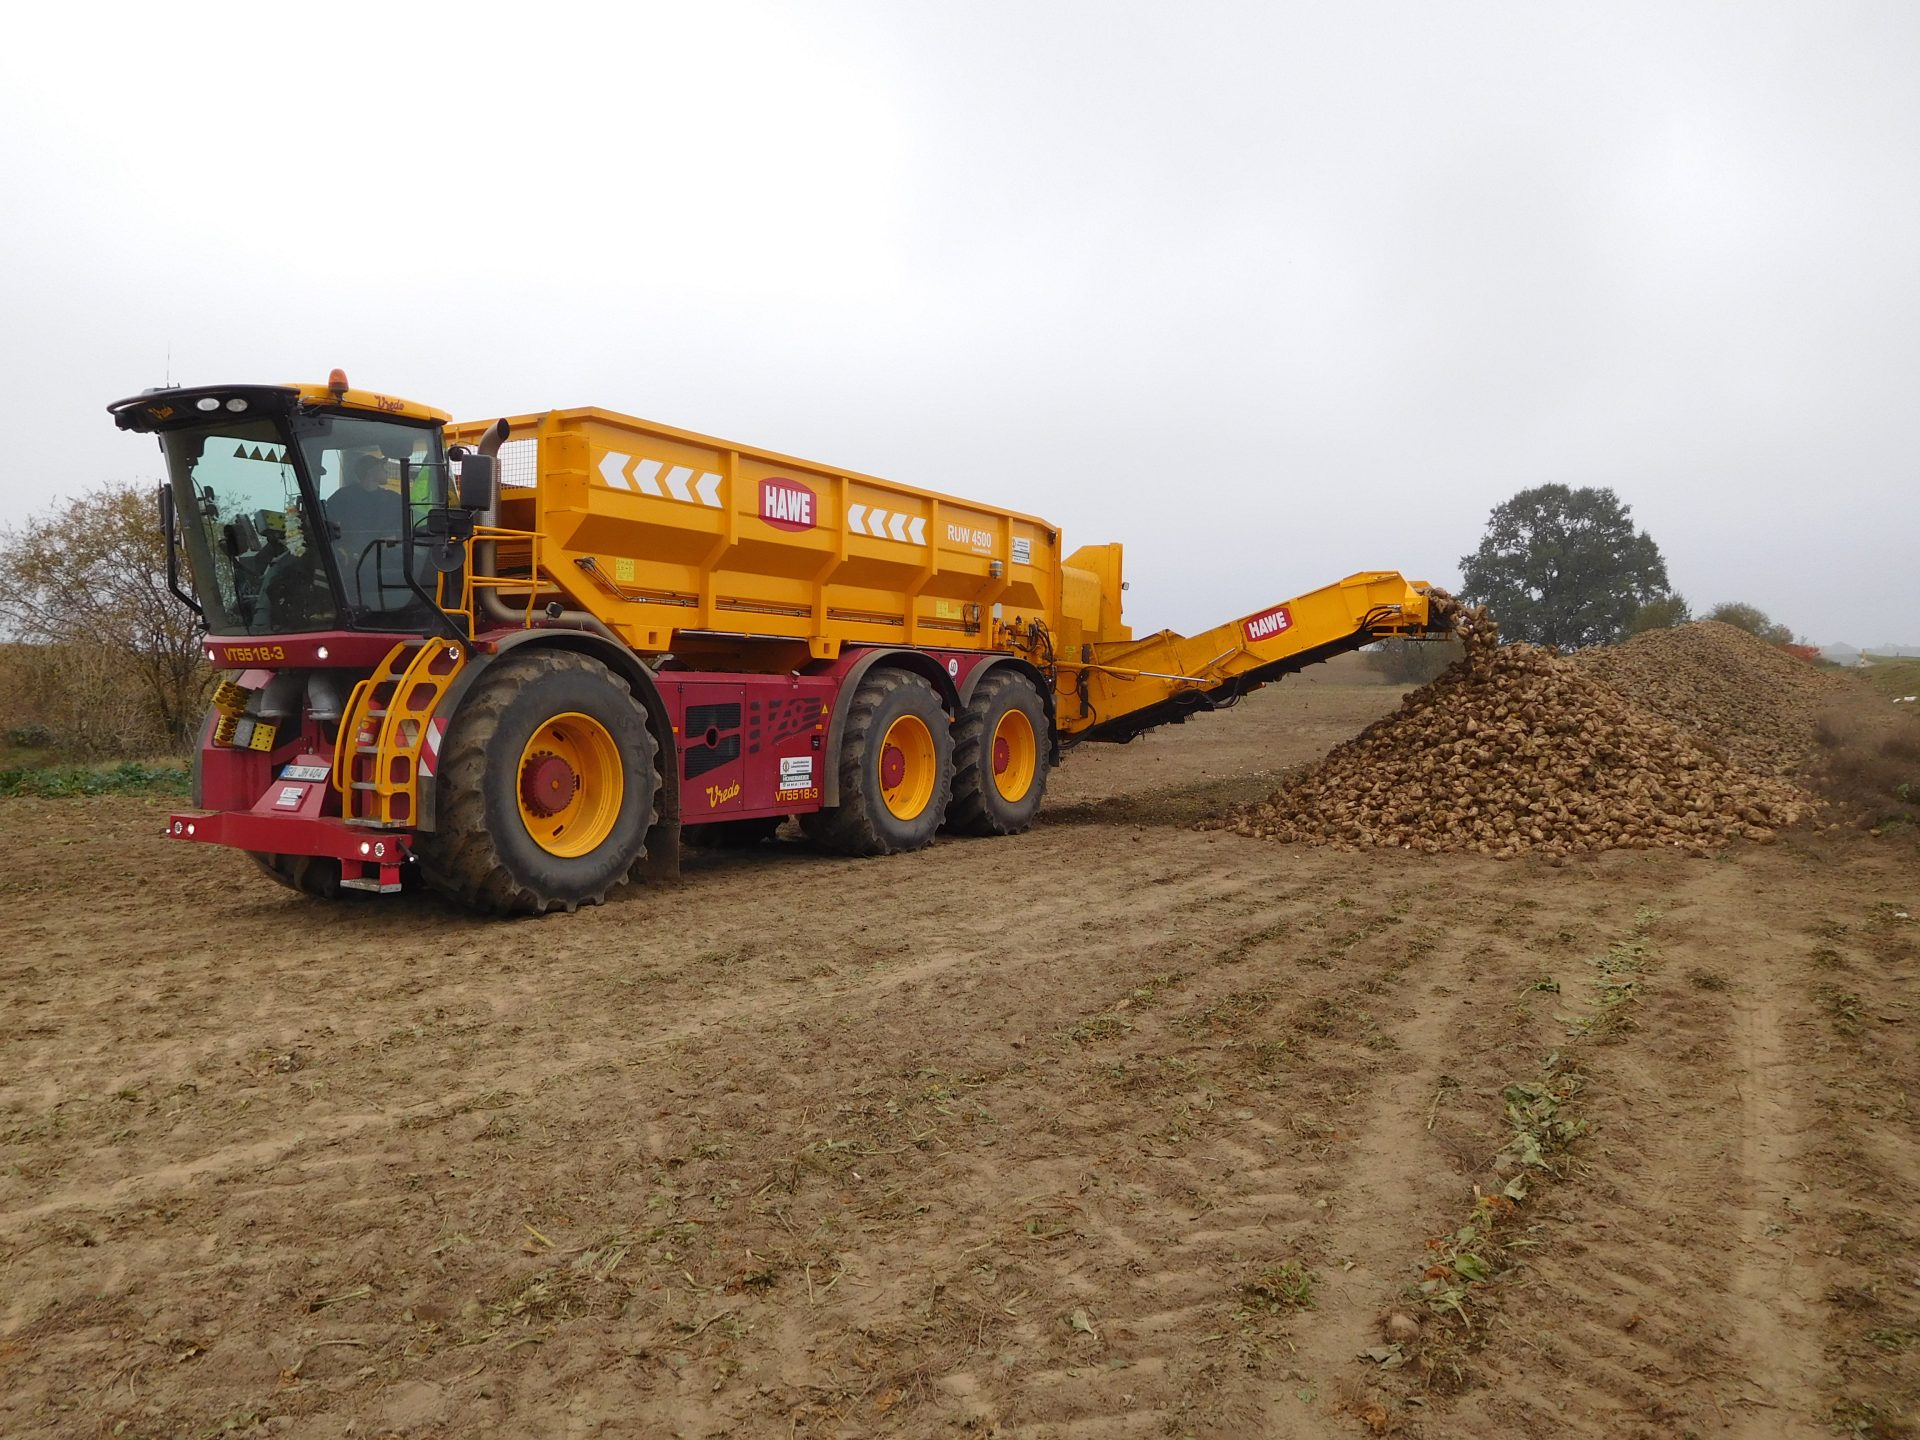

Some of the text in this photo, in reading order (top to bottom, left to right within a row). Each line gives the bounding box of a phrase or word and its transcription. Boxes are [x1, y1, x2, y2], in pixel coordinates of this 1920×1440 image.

[765, 484, 811, 525] HAWE
[947, 523, 993, 549] RUW 4500
[1248, 611, 1287, 638] HAWE
[223, 645, 285, 662] VT5518-3
[705, 779, 741, 808] Vredo
[774, 787, 819, 802] VT5518-3
